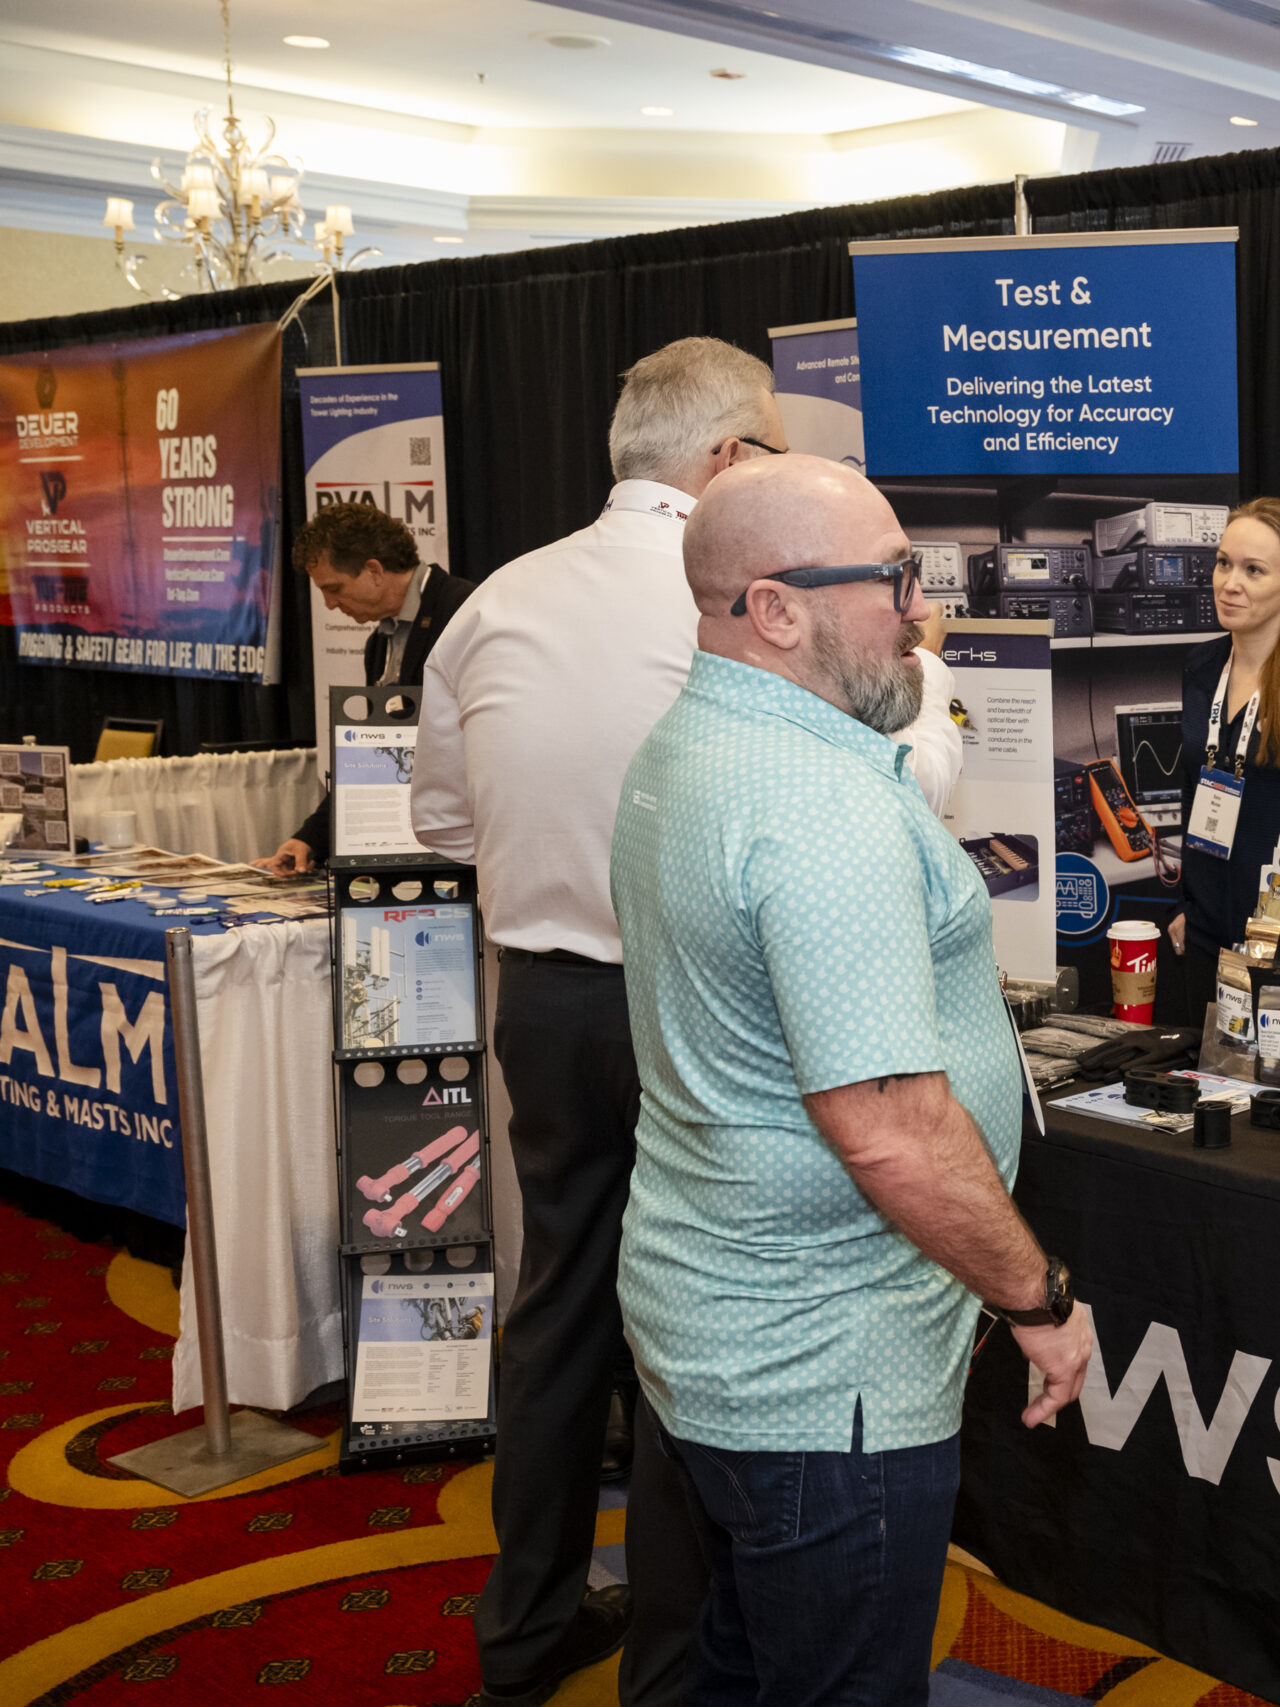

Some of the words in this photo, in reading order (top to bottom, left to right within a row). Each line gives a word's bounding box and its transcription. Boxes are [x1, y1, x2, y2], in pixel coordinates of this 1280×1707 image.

[995, 279, 1061, 306] Test
[1070, 276, 1092, 305] &
[943, 322, 1152, 352] Measurement
[835, 372, 846, 384] and
[947, 377, 1044, 399] Delivering
[1050, 376, 1082, 394] the
[1088, 375, 1152, 394] Latest
[155, 388, 179, 431] 60
[927, 404, 1041, 427] Technology
[1047, 404, 1074, 422] for
[1079, 404, 1174, 426] Accuracy
[984, 433, 1020, 451] and
[1026, 432, 1119, 455] Efficiency
[159, 434, 217, 480] YEARS
[162, 484, 234, 528] STRONG
[26, 519, 87, 535] VERTICAL
[418, 527, 436, 537] INC
[35, 603, 91, 614] PRODUCTS
[19, 632, 63, 659] RIGGING
[64, 635, 74, 660] &
[75, 635, 114, 662] SAFETY
[115, 637, 144, 665] GEAR
[145, 640, 167, 667] FOR
[168, 641, 192, 669] LIFE
[194, 643, 213, 671] ON
[215, 644, 236, 672] THE
[1021, 697, 1036, 705] reach
[987, 717, 1005, 725] optical
[434, 933, 465, 942] nws
[1225, 991, 1243, 1005] nws
[443, 1086, 473, 1105] ITL
[46, 1090, 61, 1118] &
[63, 1094, 132, 1136] MASTS
[134, 1112, 173, 1148] INC
[420, 1112, 443, 1122] TOOL
[444, 1109, 473, 1120] RANGE
